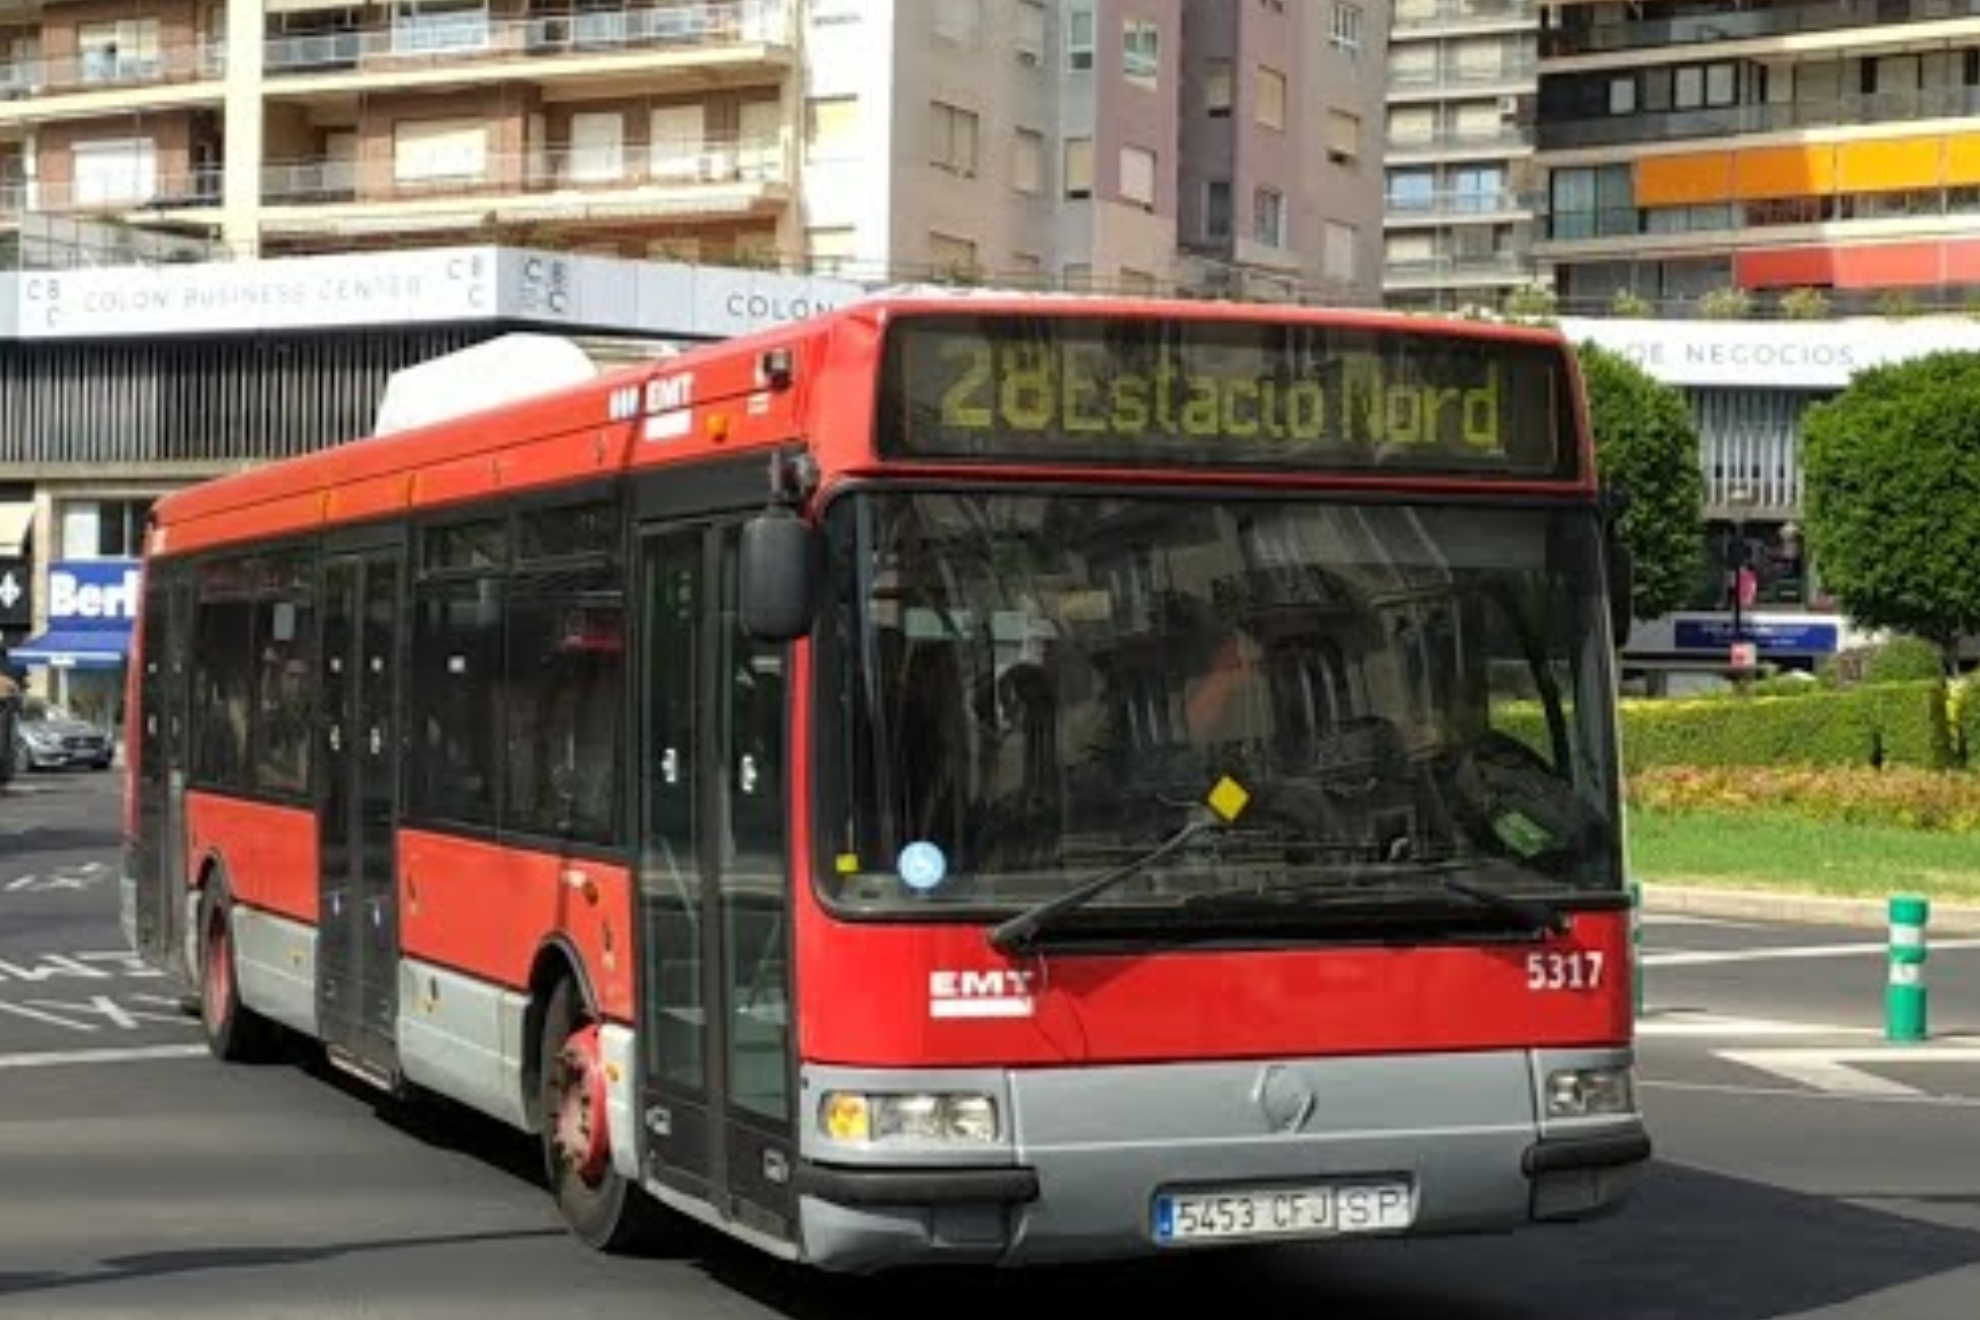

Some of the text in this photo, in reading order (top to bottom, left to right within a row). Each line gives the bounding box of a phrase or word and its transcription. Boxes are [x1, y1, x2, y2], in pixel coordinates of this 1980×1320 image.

[183, 282, 304, 309] BUSINESS
[318, 275, 420, 300] CENTER
[1685, 342, 1855, 366] NEGOCIOS
[941, 338, 1056, 430] 28
[1342, 354, 1499, 445] Nord
[929, 970, 1033, 997] EMT
[1527, 951, 1604, 990] 5317
[1178, 1197, 1254, 1233] 5453
[1274, 1193, 1328, 1228] CFJ
